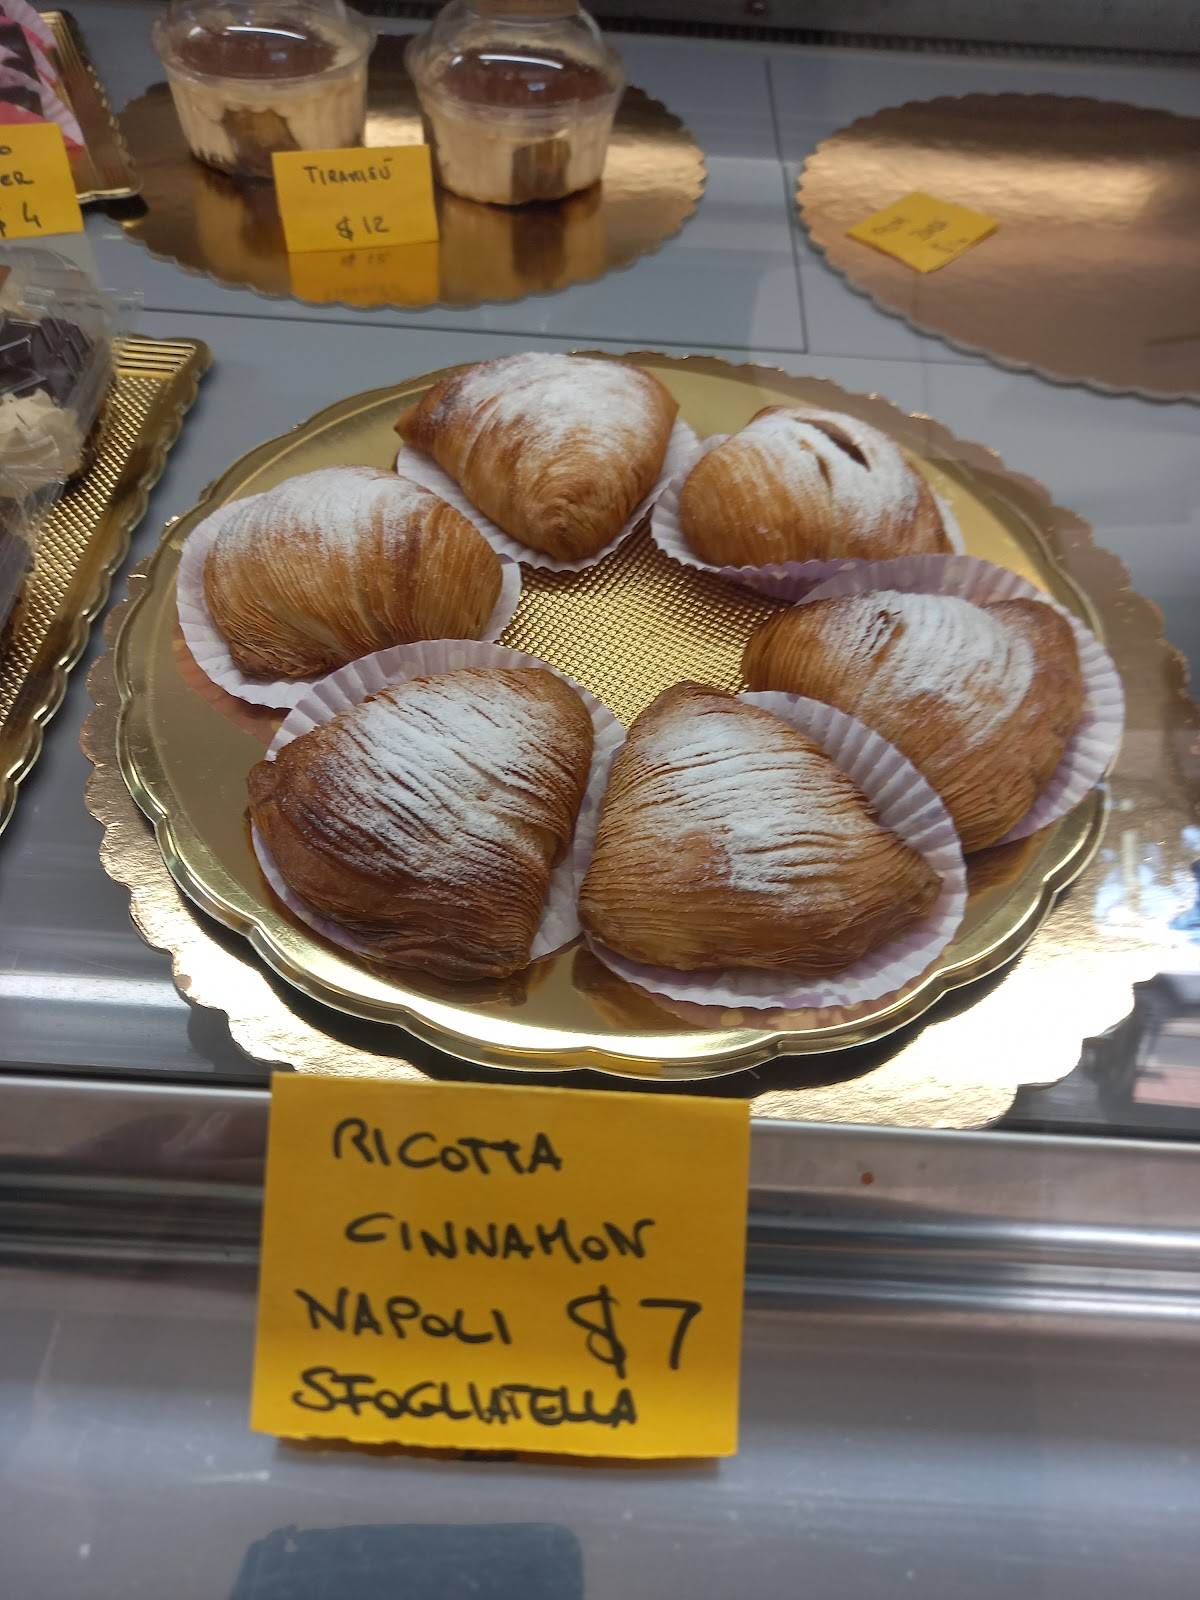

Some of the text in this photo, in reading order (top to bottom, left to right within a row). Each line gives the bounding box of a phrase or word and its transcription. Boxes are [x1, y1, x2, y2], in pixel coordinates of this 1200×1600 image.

[333, 1117, 562, 1175] RICOTTA
[345, 1213, 655, 1264] CINNAMON
[295, 1287, 511, 1345] NAPOLI
[292, 1366, 637, 1428] SFOGLIATELLA
